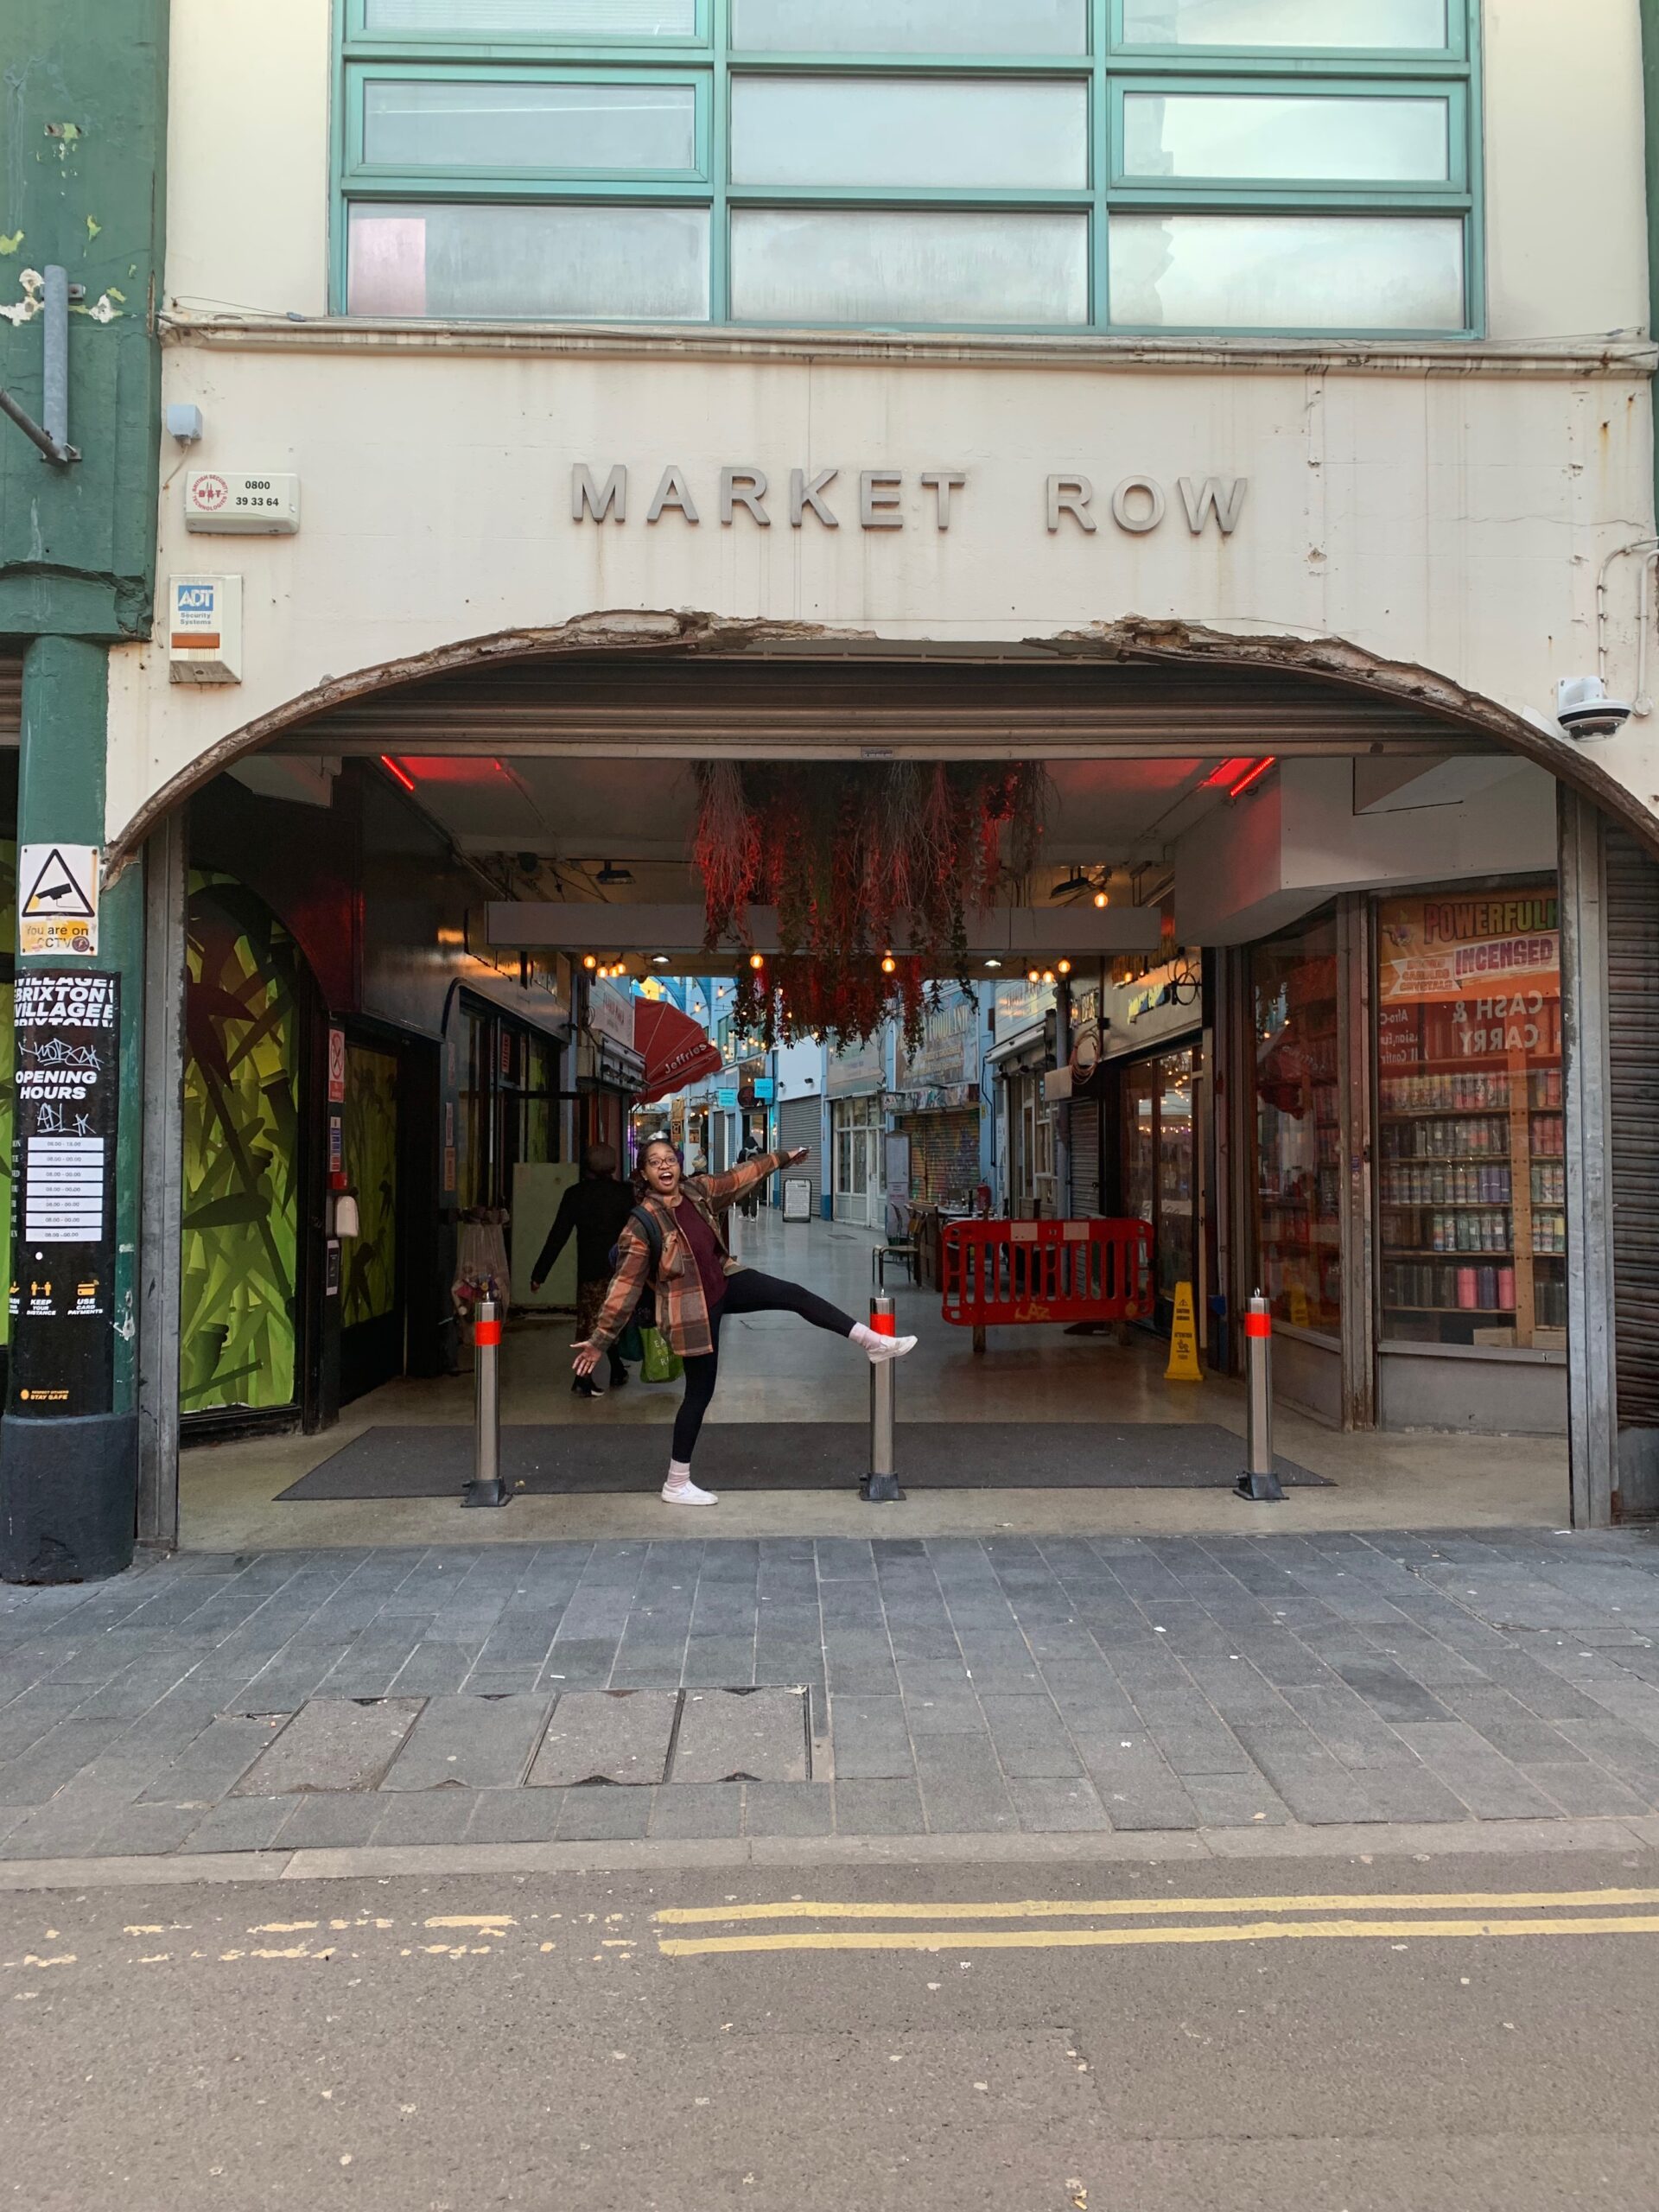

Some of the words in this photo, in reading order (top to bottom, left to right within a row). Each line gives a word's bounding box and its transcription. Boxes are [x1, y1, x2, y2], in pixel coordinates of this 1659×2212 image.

[245, 480, 270, 490] 0800
[235, 497, 249, 506] 39
[251, 497, 264, 506] 33
[266, 498, 279, 507] 64
[571, 462, 966, 531] MARKET
[1046, 474, 1249, 536] ROW
[178, 589, 214, 607] ADT
[27, 925, 44, 935] You
[48, 926, 67, 935] are
[72, 927, 89, 936] on
[37, 938, 71, 948] CCTV
[1455, 938, 1554, 976] INCENSED
[15, 986, 105, 1002] BRIXTON
[15, 1002, 102, 1018] VILLAGE
[664, 1044, 707, 1074] Jeffries
[15, 1071, 98, 1084] OPENING
[20, 1086, 86, 1099] HOURS
